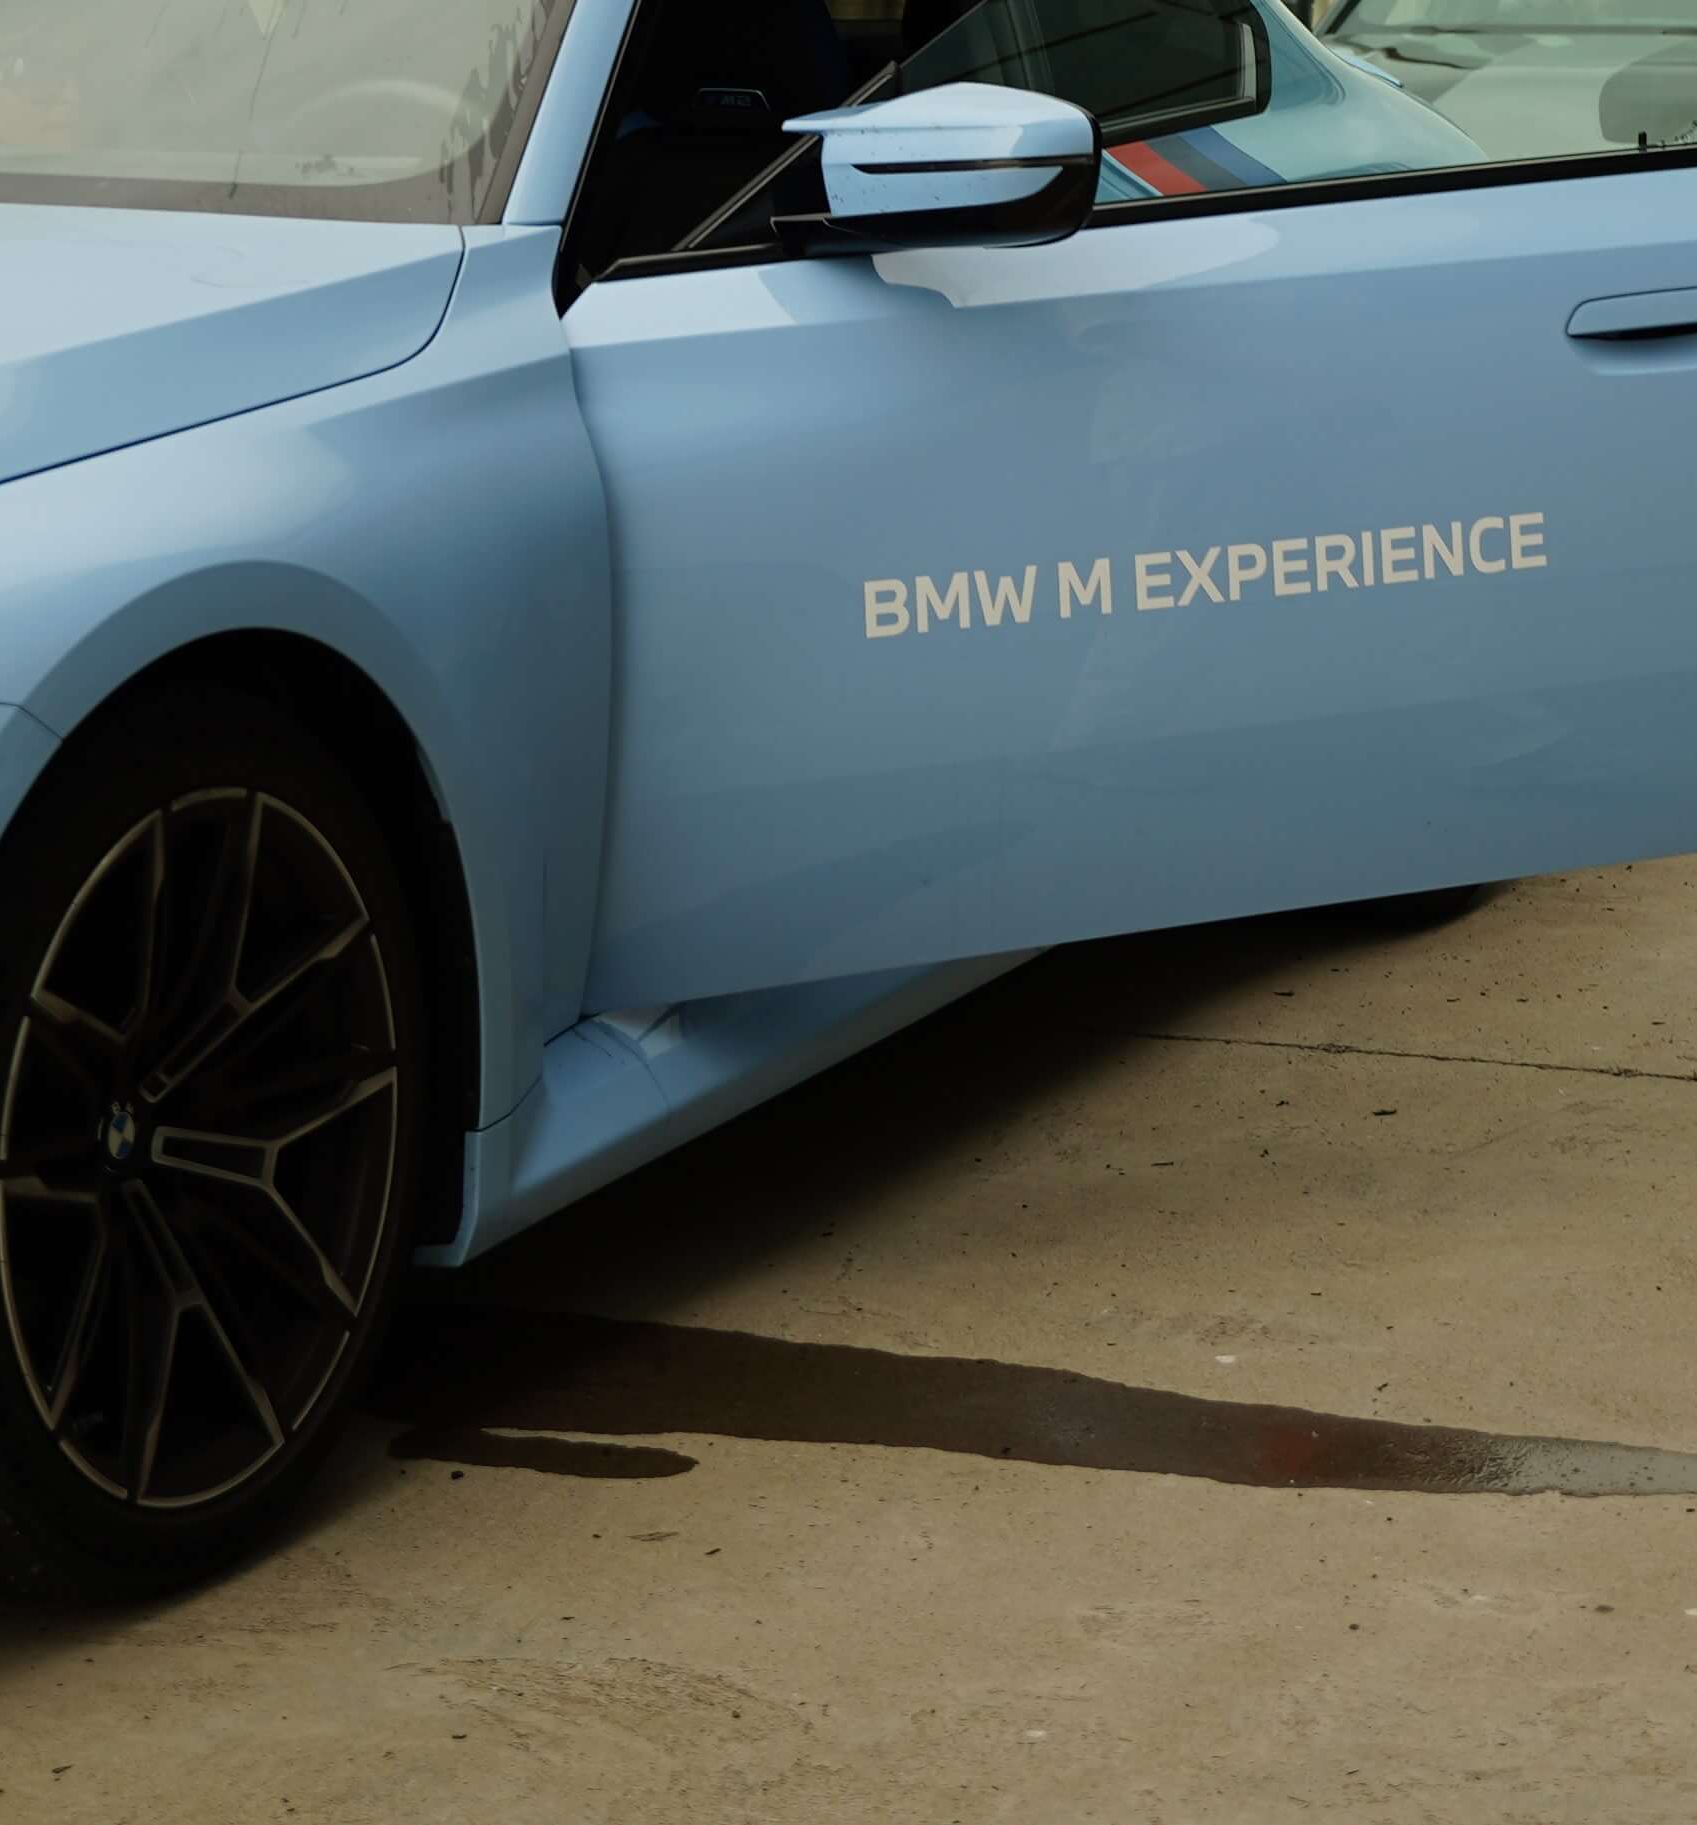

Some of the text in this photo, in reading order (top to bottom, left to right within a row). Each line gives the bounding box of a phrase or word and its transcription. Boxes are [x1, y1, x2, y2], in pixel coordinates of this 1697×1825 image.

[863, 511, 1548, 639] BMW M EXPERIENCE
